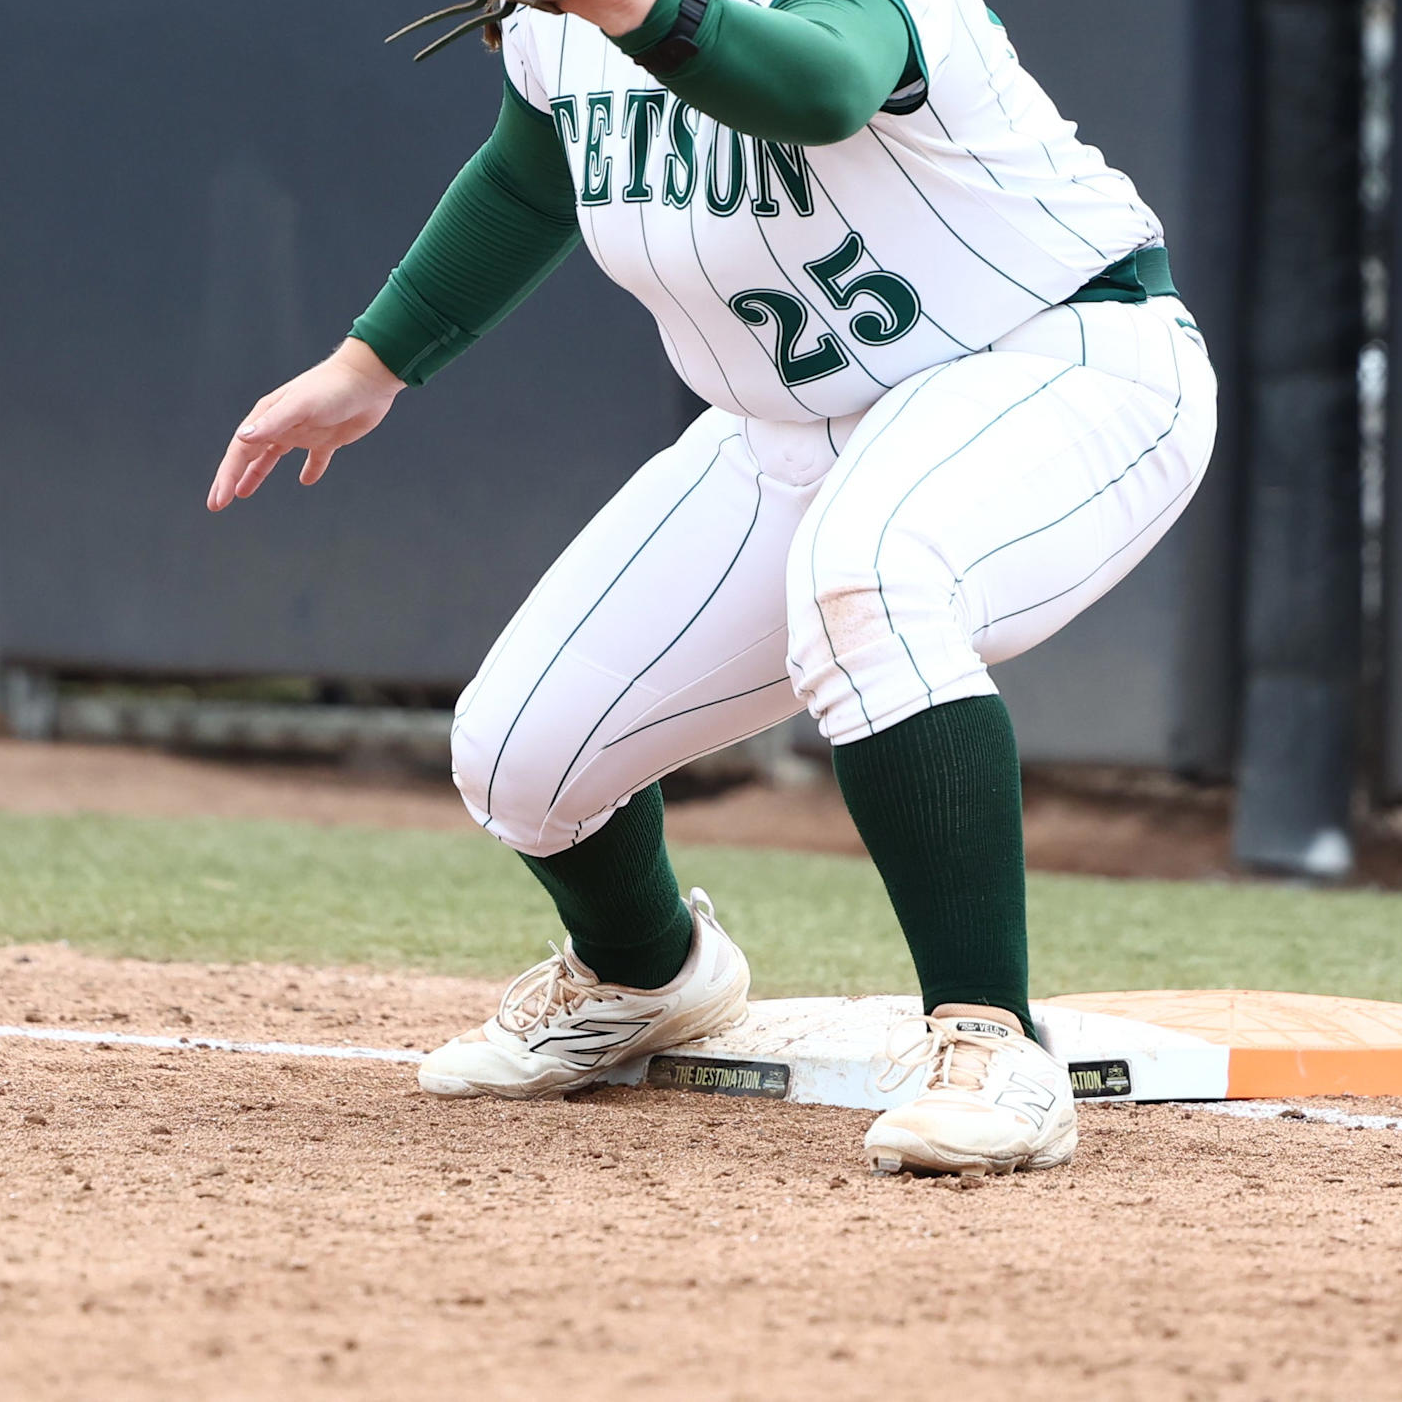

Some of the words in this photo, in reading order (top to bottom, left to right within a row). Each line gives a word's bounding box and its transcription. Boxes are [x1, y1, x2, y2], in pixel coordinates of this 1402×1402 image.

[729, 232, 921, 388] 25
[674, 1064, 695, 1084] THE
[694, 1066, 762, 1090] DESTINATION.
